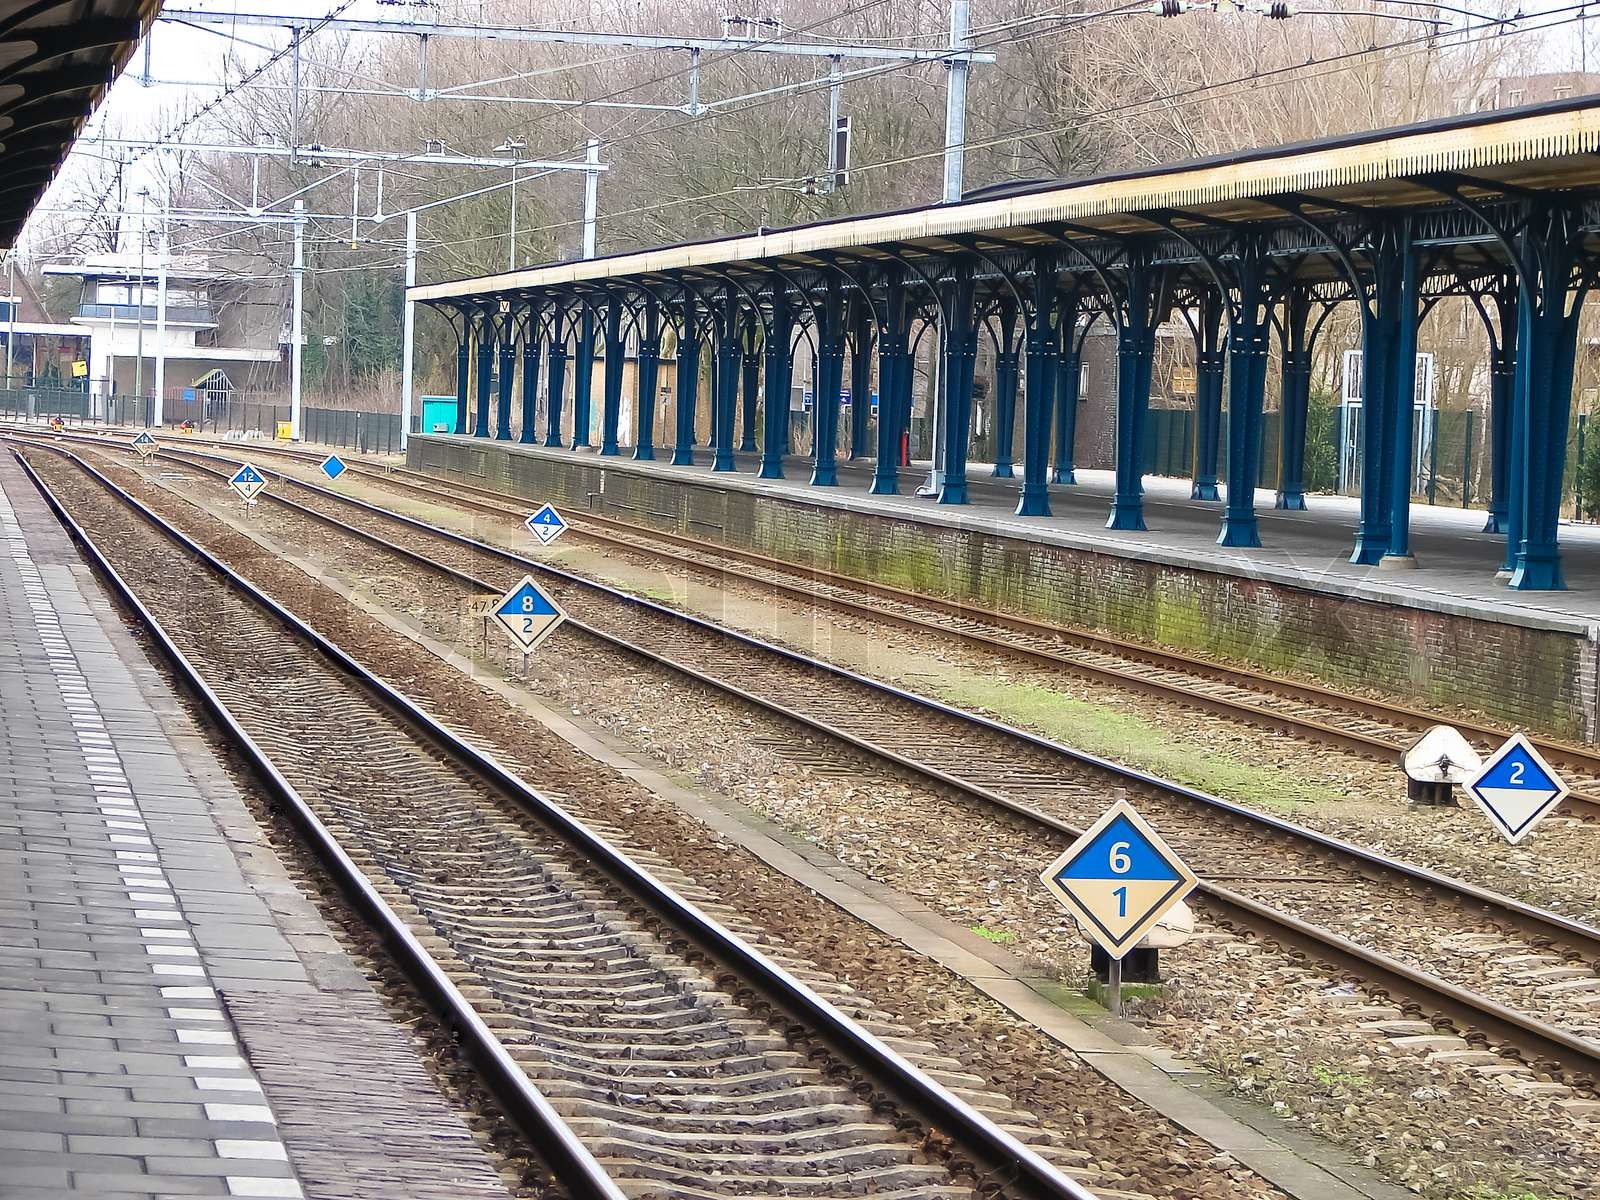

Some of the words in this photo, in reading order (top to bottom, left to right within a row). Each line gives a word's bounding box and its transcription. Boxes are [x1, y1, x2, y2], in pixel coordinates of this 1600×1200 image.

[501, 302, 509, 312] V
[242, 472, 254, 482] 12
[245, 484, 251, 492] 4
[543, 513, 552, 524] 4
[542, 526, 549, 535] 2
[522, 596, 534, 612] 8
[522, 618, 533, 633] 2
[1509, 761, 1525, 785] 2
[1109, 841, 1132, 874] 6
[1112, 886, 1127, 917] 1
